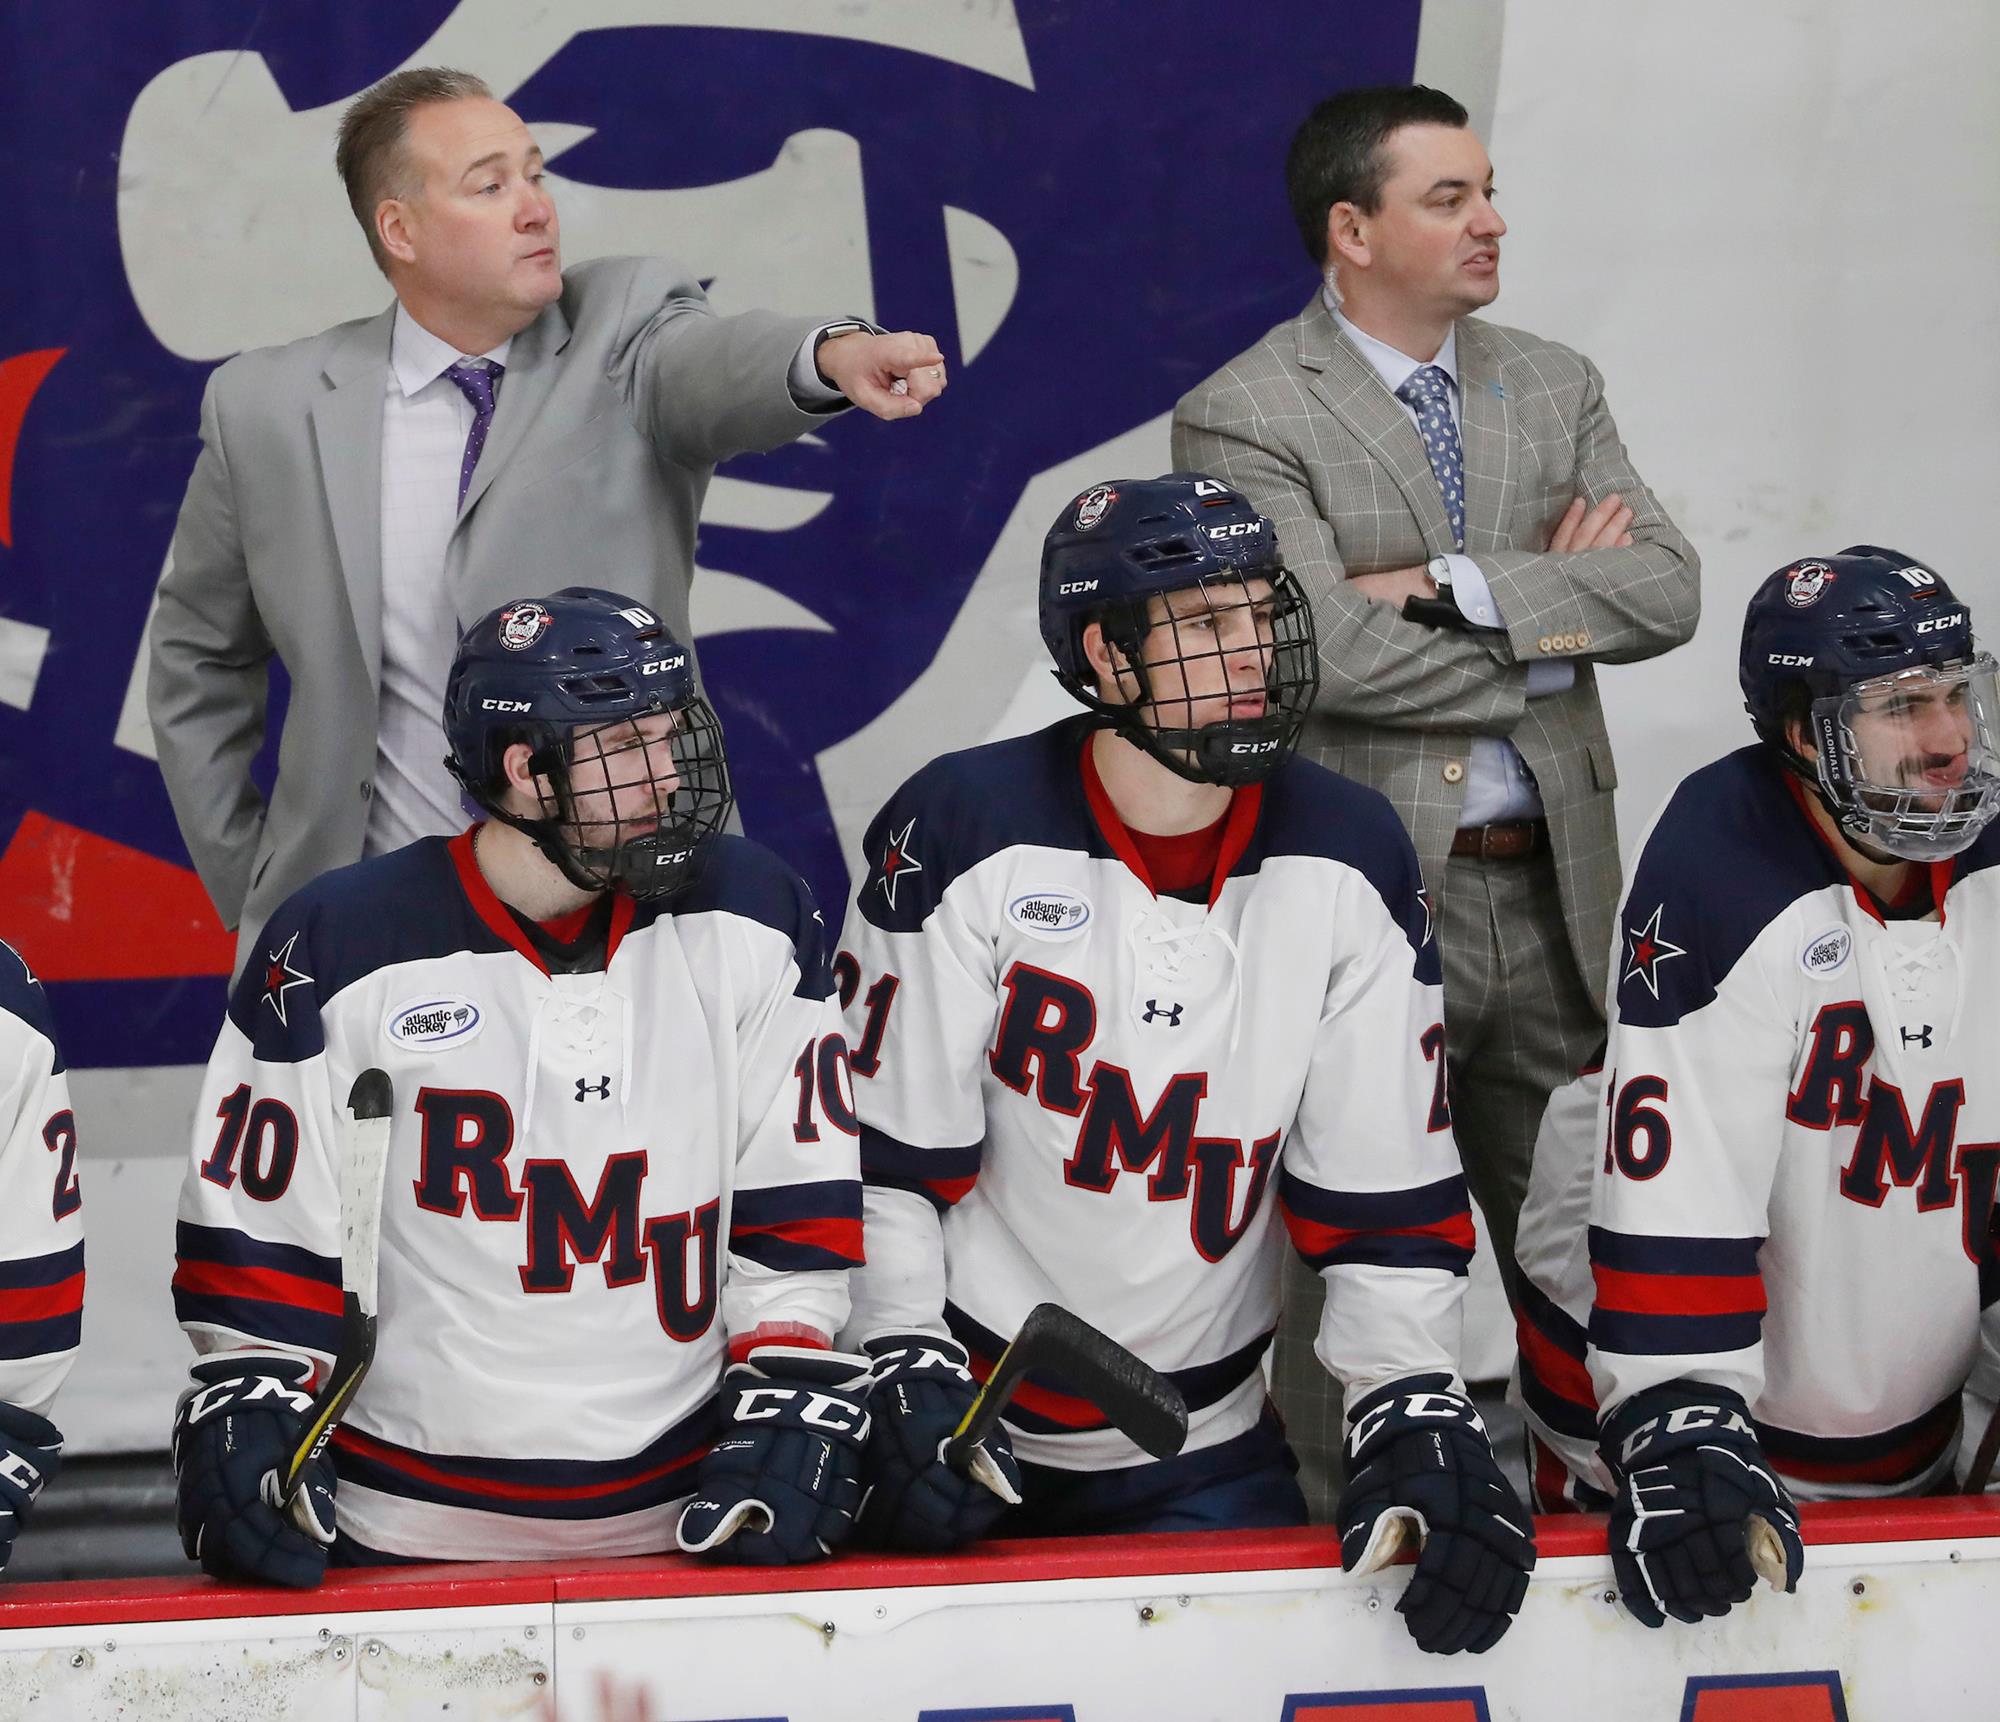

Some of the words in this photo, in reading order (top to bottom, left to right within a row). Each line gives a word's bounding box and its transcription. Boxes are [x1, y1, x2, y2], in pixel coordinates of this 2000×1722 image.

[1209, 522, 1260, 539] CCM
[1059, 579, 1099, 596] CCM
[1916, 613, 1962, 634] CCM
[642, 654, 685, 676] CCM
[1767, 653, 1815, 667] CCM
[481, 698, 532, 713] CCM
[1823, 718, 1841, 781] COLONIALS
[1020, 907, 1062, 926] hockey
[1026, 900, 1068, 915] atlantic
[1812, 939, 1840, 957] atlantic
[1810, 950, 1839, 967] hockey
[405, 1009, 452, 1026] atlantic
[402, 1021, 447, 1037] hockey
[793, 1033, 860, 1143] 10
[989, 960, 1281, 1263] RMU
[200, 1083, 298, 1202] 10
[413, 1086, 721, 1343] RMU
[308, 1423, 338, 1460] CCM
[1621, 1405, 1759, 1465] CCM
